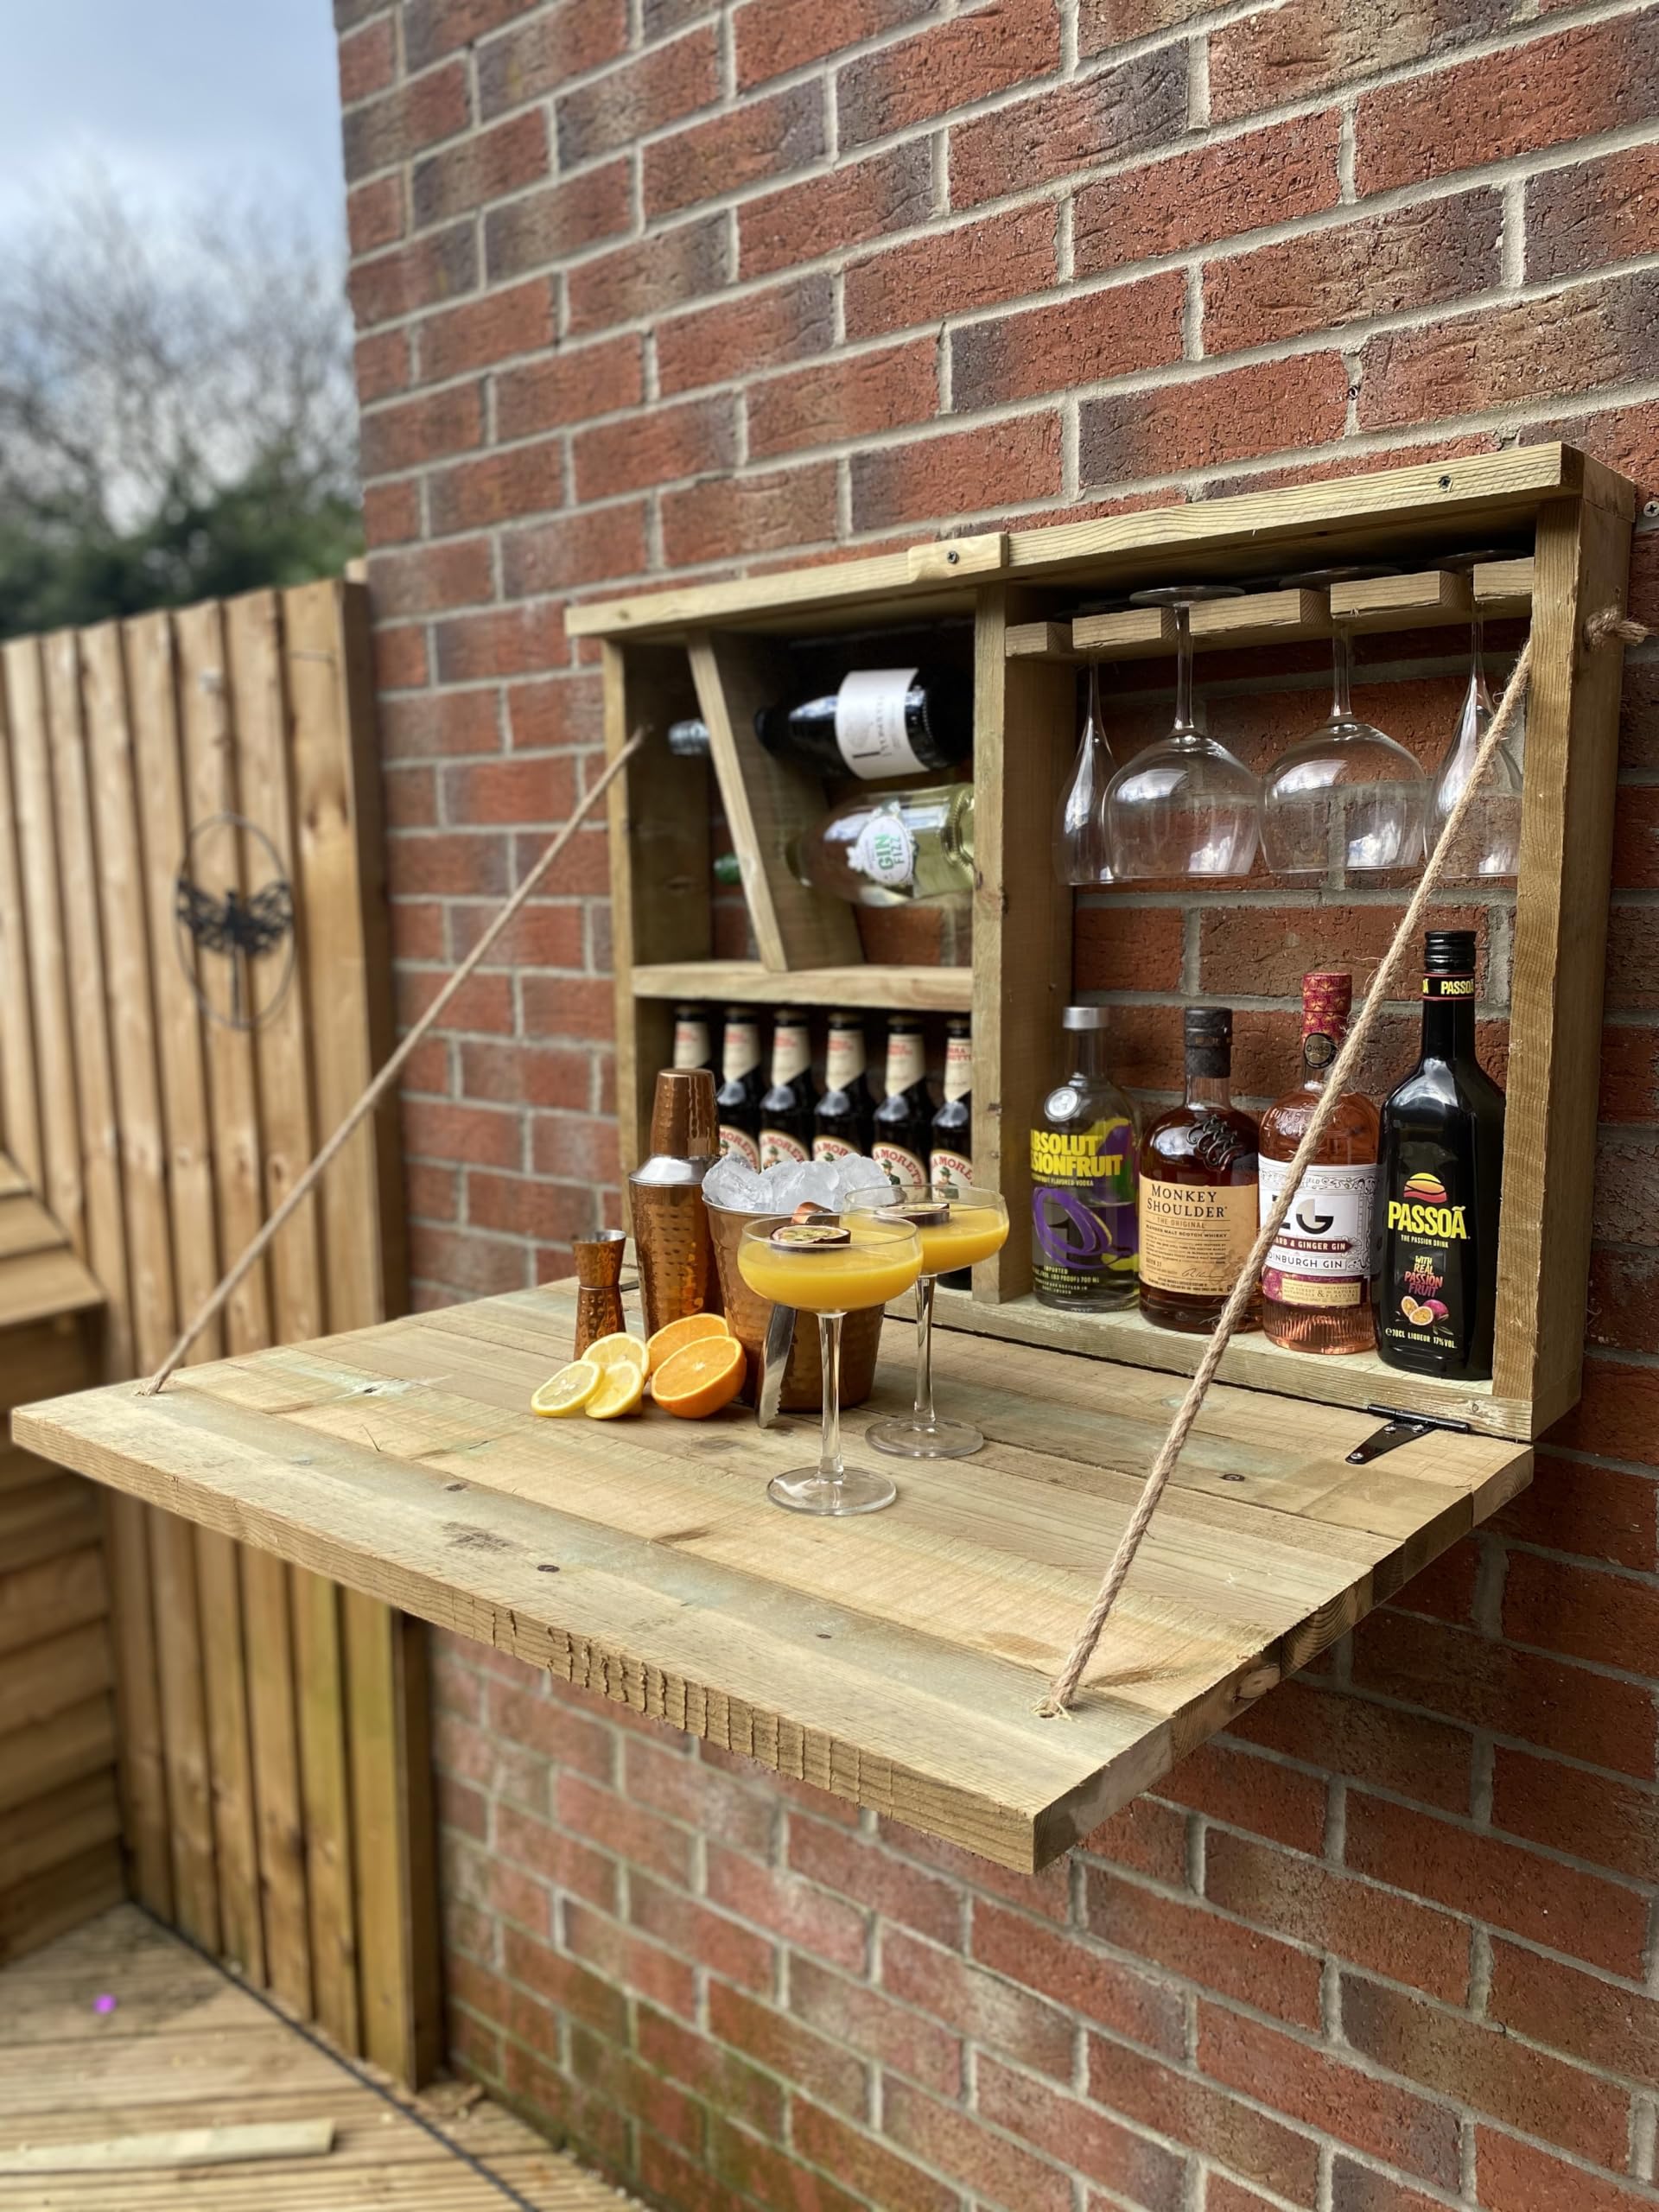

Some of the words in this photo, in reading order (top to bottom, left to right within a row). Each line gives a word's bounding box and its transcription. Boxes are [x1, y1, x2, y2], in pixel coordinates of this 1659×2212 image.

[874, 834, 894, 870] GIN
[891, 836, 905, 864] FIZZ
[1031, 1128, 1098, 1155] BSOLUT
[939, 1156, 972, 1185] MORE
[1031, 1151, 1122, 1177] SIONFRUIT
[1152, 1184, 1217, 1203] MONKEY
[1147, 1198, 1224, 1217] SHOULDER
[1171, 1219, 1205, 1229] ORIGINAL
[1388, 1201, 1466, 1239] PASSOÃ
[1298, 1240, 1328, 1250] GINGER
[1401, 1234, 1409, 1243] THE
[1411, 1236, 1432, 1245] PASSION
[1433, 1239, 1448, 1249] DRINK
[1268, 1251, 1318, 1268] DINBURGH
[1415, 1255, 1432, 1264] WITH
[1414, 1263, 1433, 1275] REAL
[1404, 1271, 1443, 1287] PASSION
[1408, 1282, 1439, 1298] FRUIT
[1408, 1332, 1430, 1342] LIQUEUR
